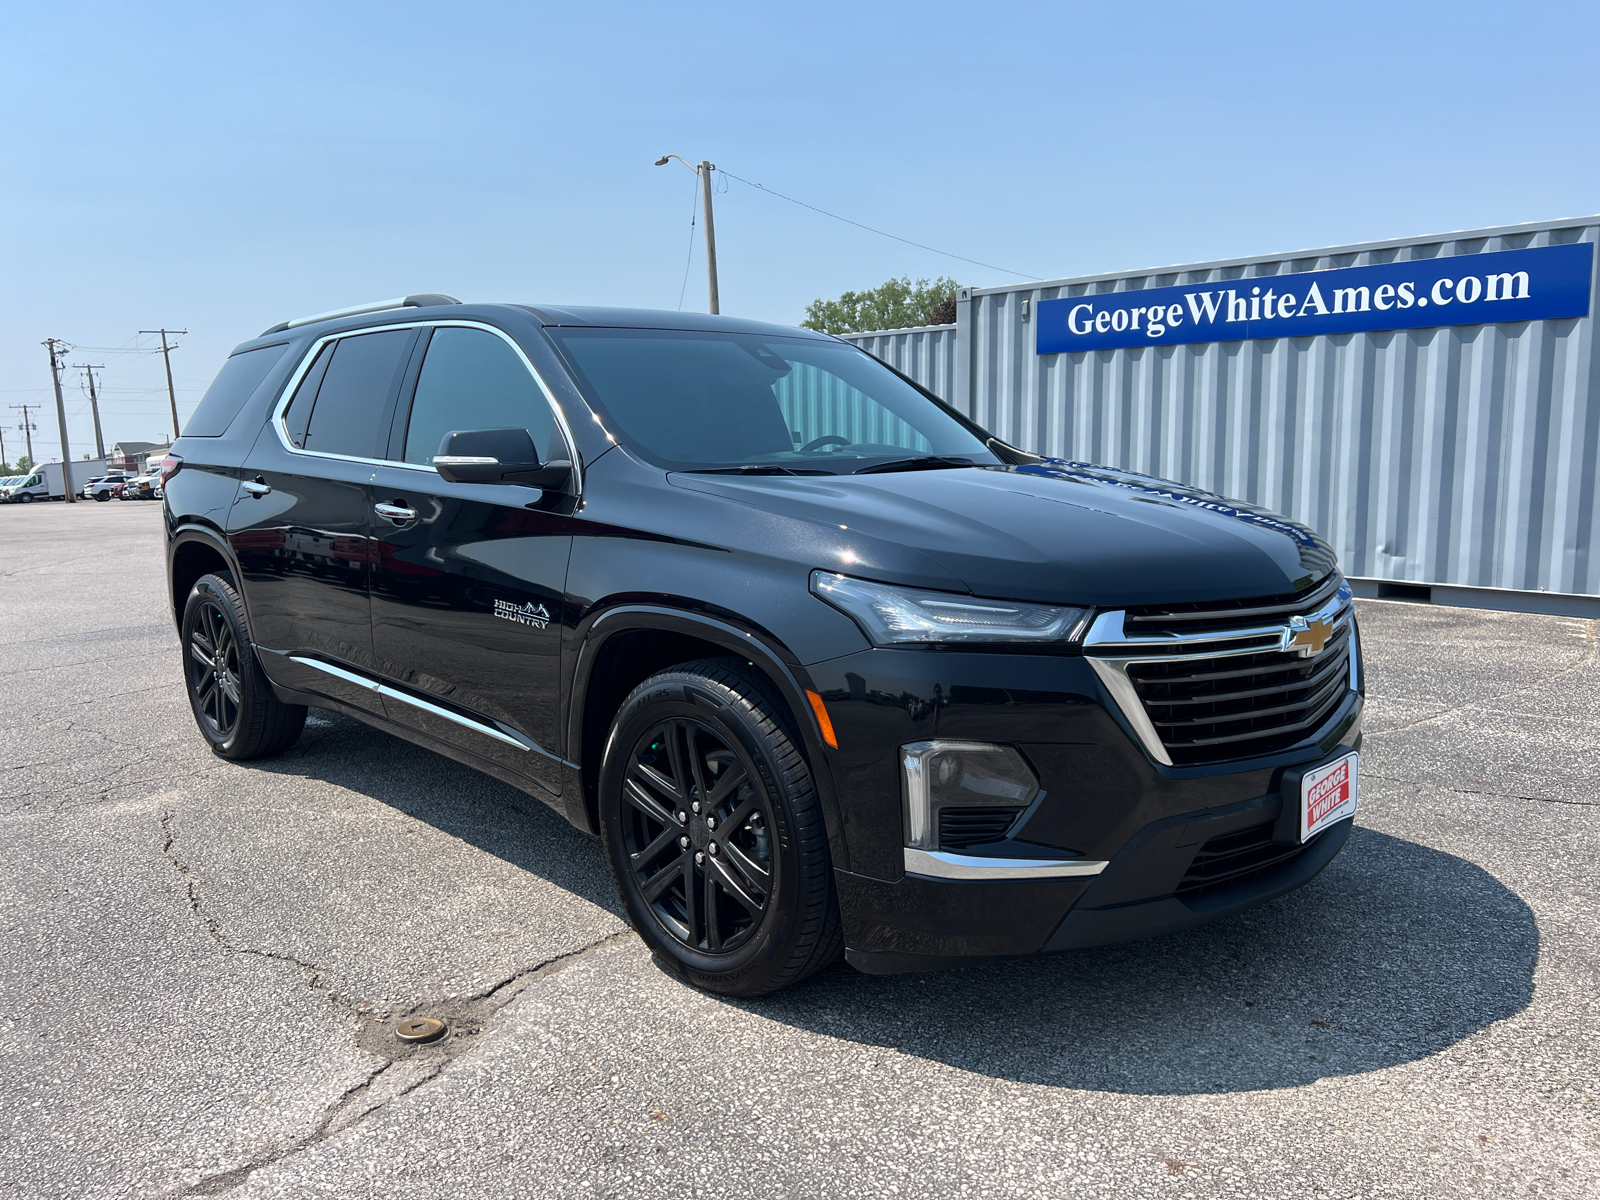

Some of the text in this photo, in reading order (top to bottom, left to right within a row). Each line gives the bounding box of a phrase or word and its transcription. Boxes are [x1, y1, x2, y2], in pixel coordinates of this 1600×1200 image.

[1067, 269, 1531, 338] GeorgeWhiteAmes.com
[494, 599, 522, 613] HIGH
[494, 608, 549, 630] COUNTRY
[637, 692, 653, 709] FIT
[1309, 765, 1347, 806] GEORGE
[1312, 787, 1342, 822] WHITE
[698, 960, 758, 983] 255/55ZR20
